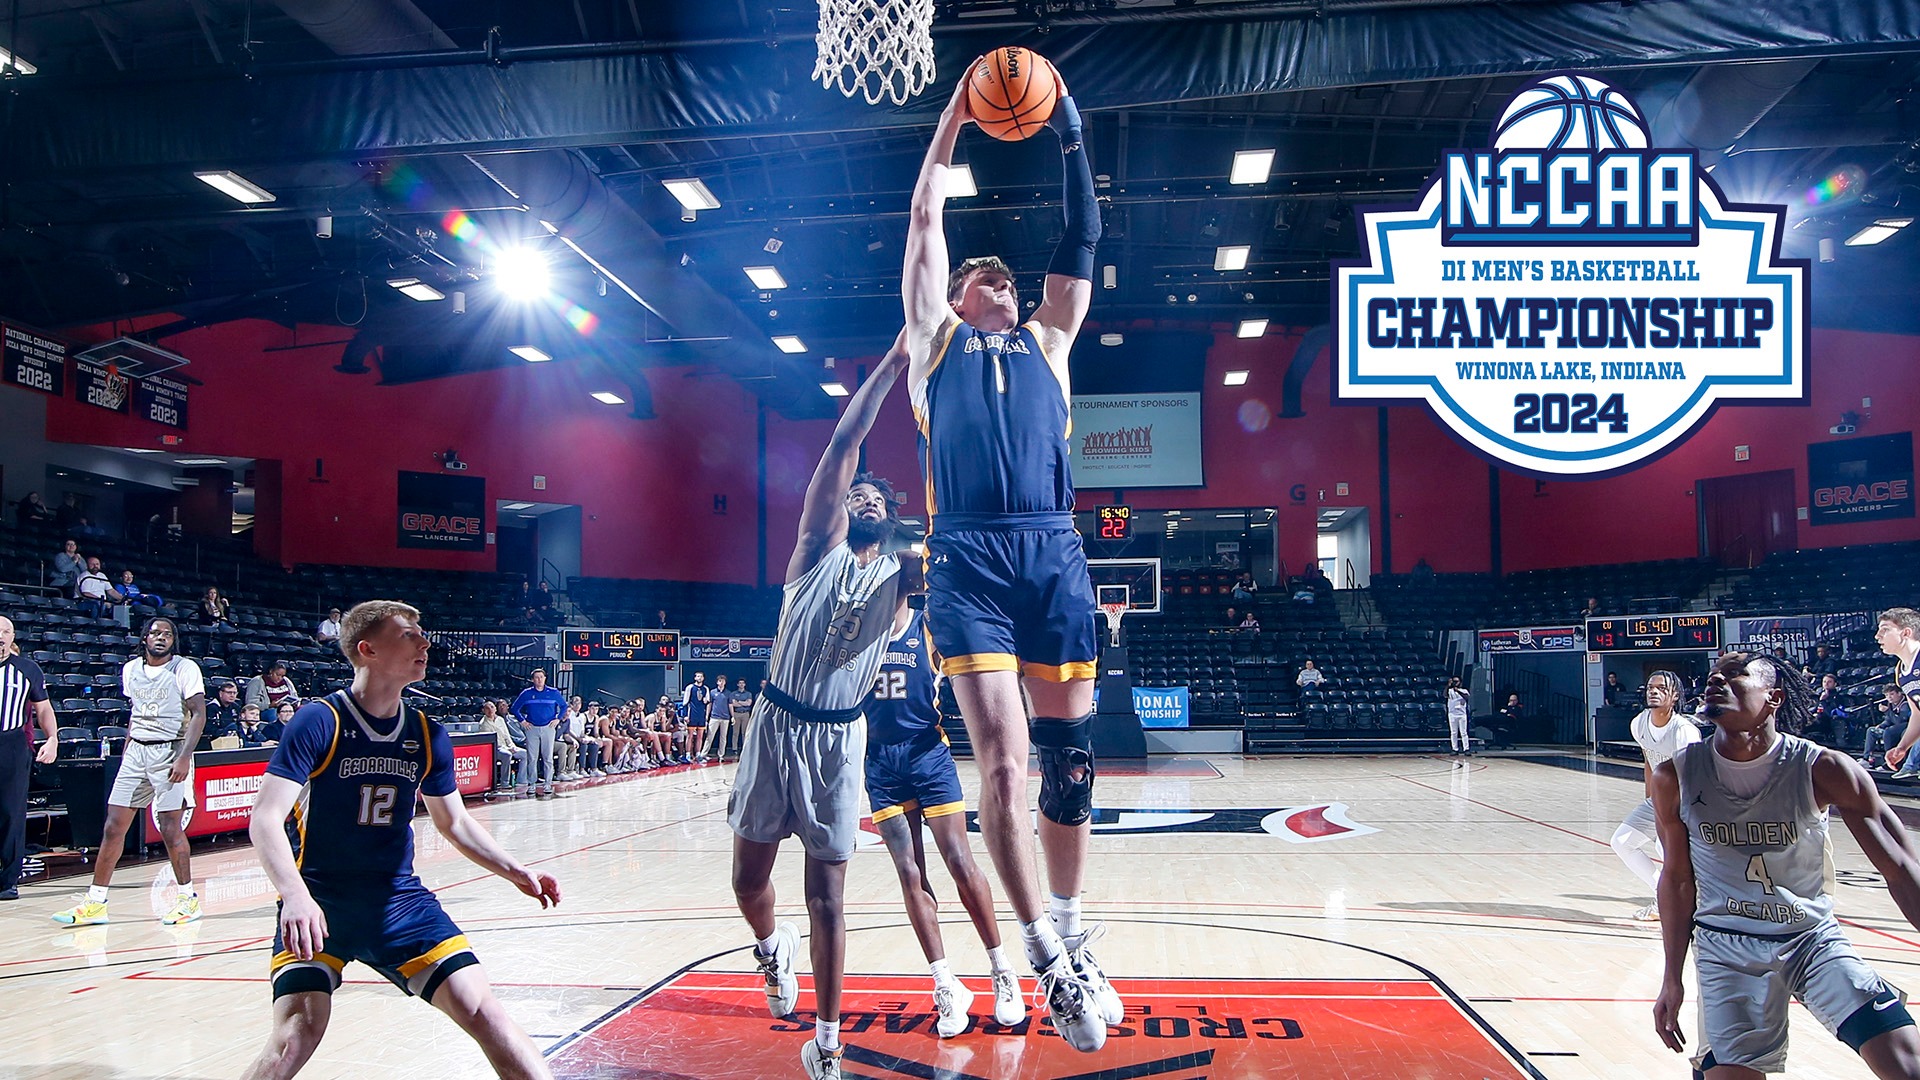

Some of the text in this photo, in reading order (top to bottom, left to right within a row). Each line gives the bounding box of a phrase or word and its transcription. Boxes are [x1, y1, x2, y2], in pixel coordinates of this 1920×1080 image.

[5, 327, 65, 354] NATIONAL CHAMPIONS
[5, 339, 19, 350] NCCAA
[20, 343, 33, 354] MEN'S
[23, 355, 44, 368] DIVISION
[77, 362, 92, 374] NCCAA
[17, 364, 52, 391] 2022
[993, 355, 1006, 394] 1
[141, 382, 156, 393] NCCAA
[163, 378, 188, 393] CHAMPIONS
[1079, 401, 1138, 409] TOURNAMENT
[1141, 400, 1188, 408] SPONSORS
[151, 403, 178, 426] 2023
[1290, 484, 1306, 501] G
[1814, 479, 1908, 508] GRACE
[714, 495, 727, 511] H
[1840, 504, 1882, 514] LANCERS
[1101, 507, 1129, 518] 16:40
[402, 513, 480, 535] GRACE
[1102, 518, 1125, 538] 22
[828, 600, 867, 641] 25
[1603, 621, 1611, 629] CU
[1635, 619, 1669, 633] 16:40
[1678, 617, 1709, 627] CLINTON
[580, 632, 589, 640] CU
[609, 633, 640, 647] 16:40
[647, 634, 673, 642] CLINTON
[1542, 637, 1572, 646] OPS
[1596, 633, 1613, 646] 43
[1654, 637, 1661, 646] 2
[1694, 631, 1712, 642] 41
[573, 644, 590, 657] 43
[626, 649, 633, 659] 2
[659, 646, 675, 657] 41
[875, 669, 908, 700] 32
[134, 688, 169, 700] GOLDEN
[1136, 695, 1182, 709] IONAL
[141, 702, 160, 717] 13
[1135, 709, 1182, 719] PIONSHIP
[339, 757, 419, 782] CEDARVILLE
[455, 770, 478, 778] PLUMBING
[357, 784, 398, 826] 12
[1698, 822, 1798, 846] GOLDEN
[1745, 854, 1775, 896] 4
[1726, 896, 1807, 924] BEARS
